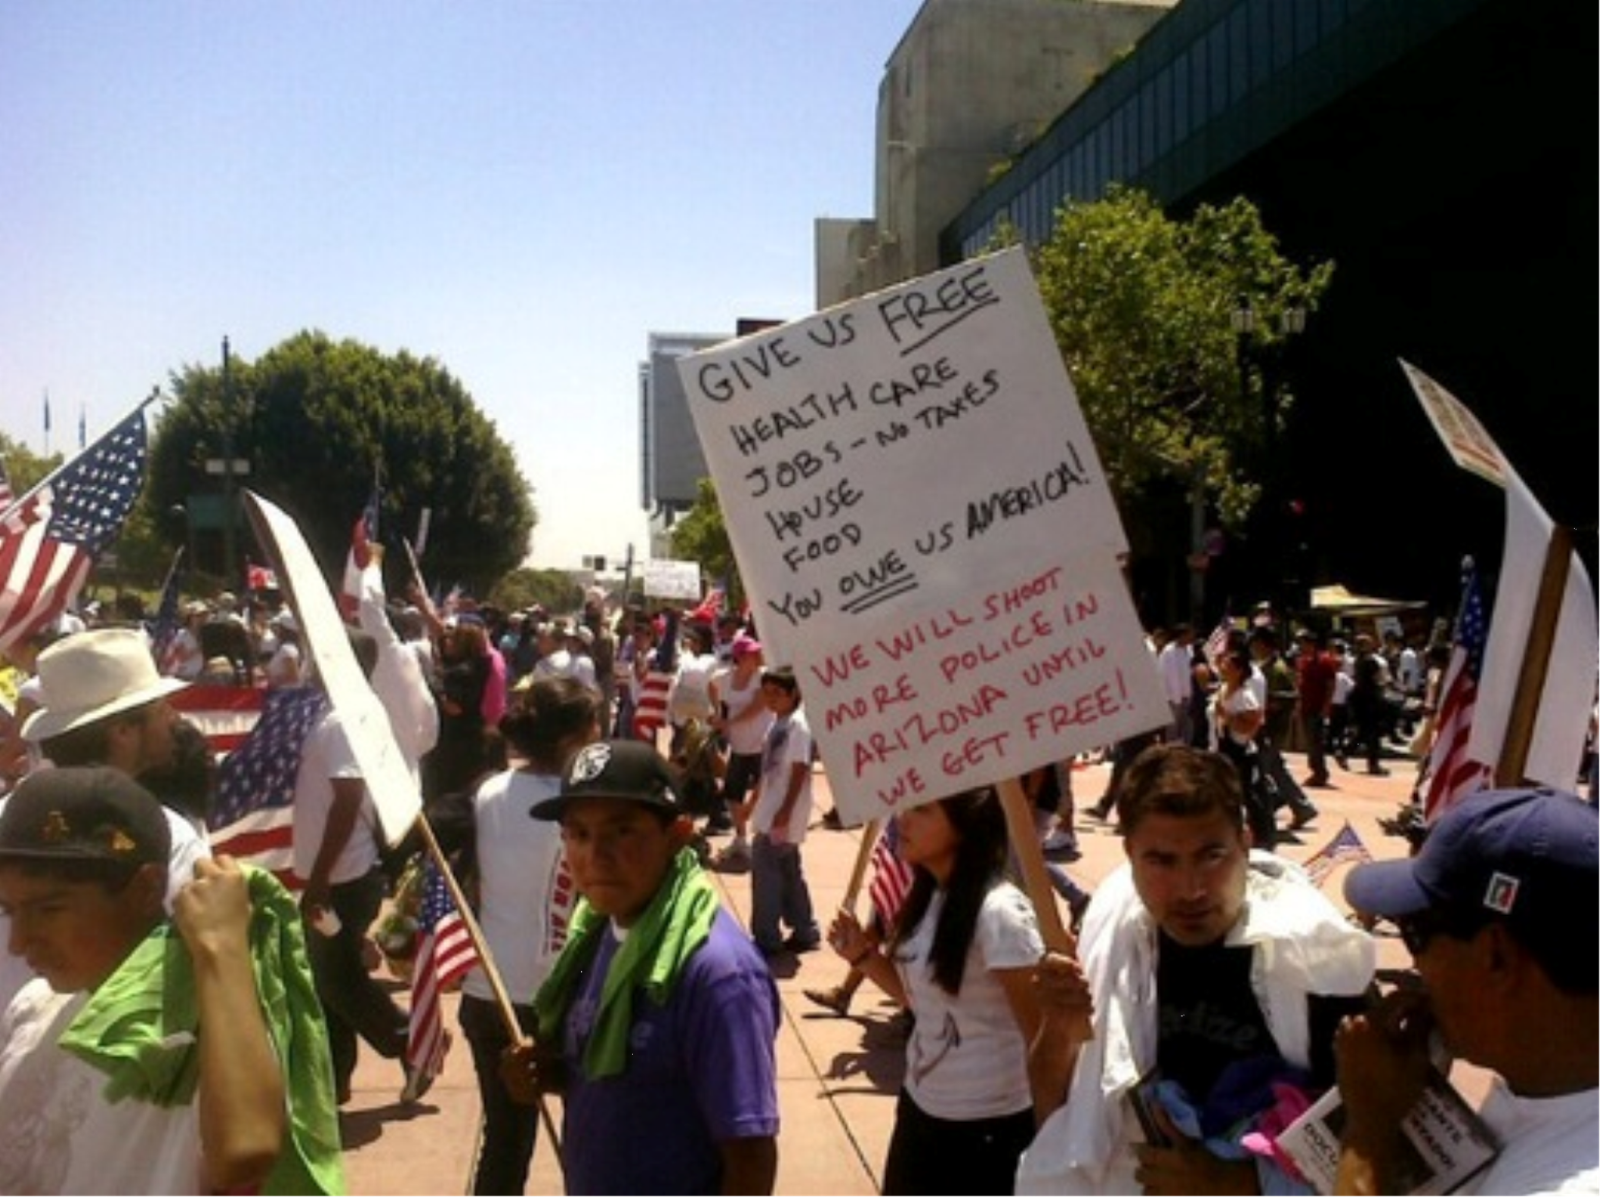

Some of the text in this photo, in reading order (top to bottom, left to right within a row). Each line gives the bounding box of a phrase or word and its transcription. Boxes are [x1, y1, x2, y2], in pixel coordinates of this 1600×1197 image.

[700, 268, 994, 403] GIVE US FREE
[730, 357, 958, 455] HEALTH CARE
[745, 443, 841, 497] JOBS
[915, 369, 998, 429] TAXES
[765, 479, 863, 541] HOUSE
[783, 523, 861, 572] FOOD
[839, 550, 906, 594] OWE
[915, 523, 953, 556] US
[967, 441, 1091, 539] AMERICA!
[811, 566, 1062, 688] WE WILL SHOOT
[826, 594, 1099, 730] MORE POLICE IN
[852, 638, 1106, 778] ARIZONA UNTIL
[878, 667, 1135, 807] WE GET FREE!
